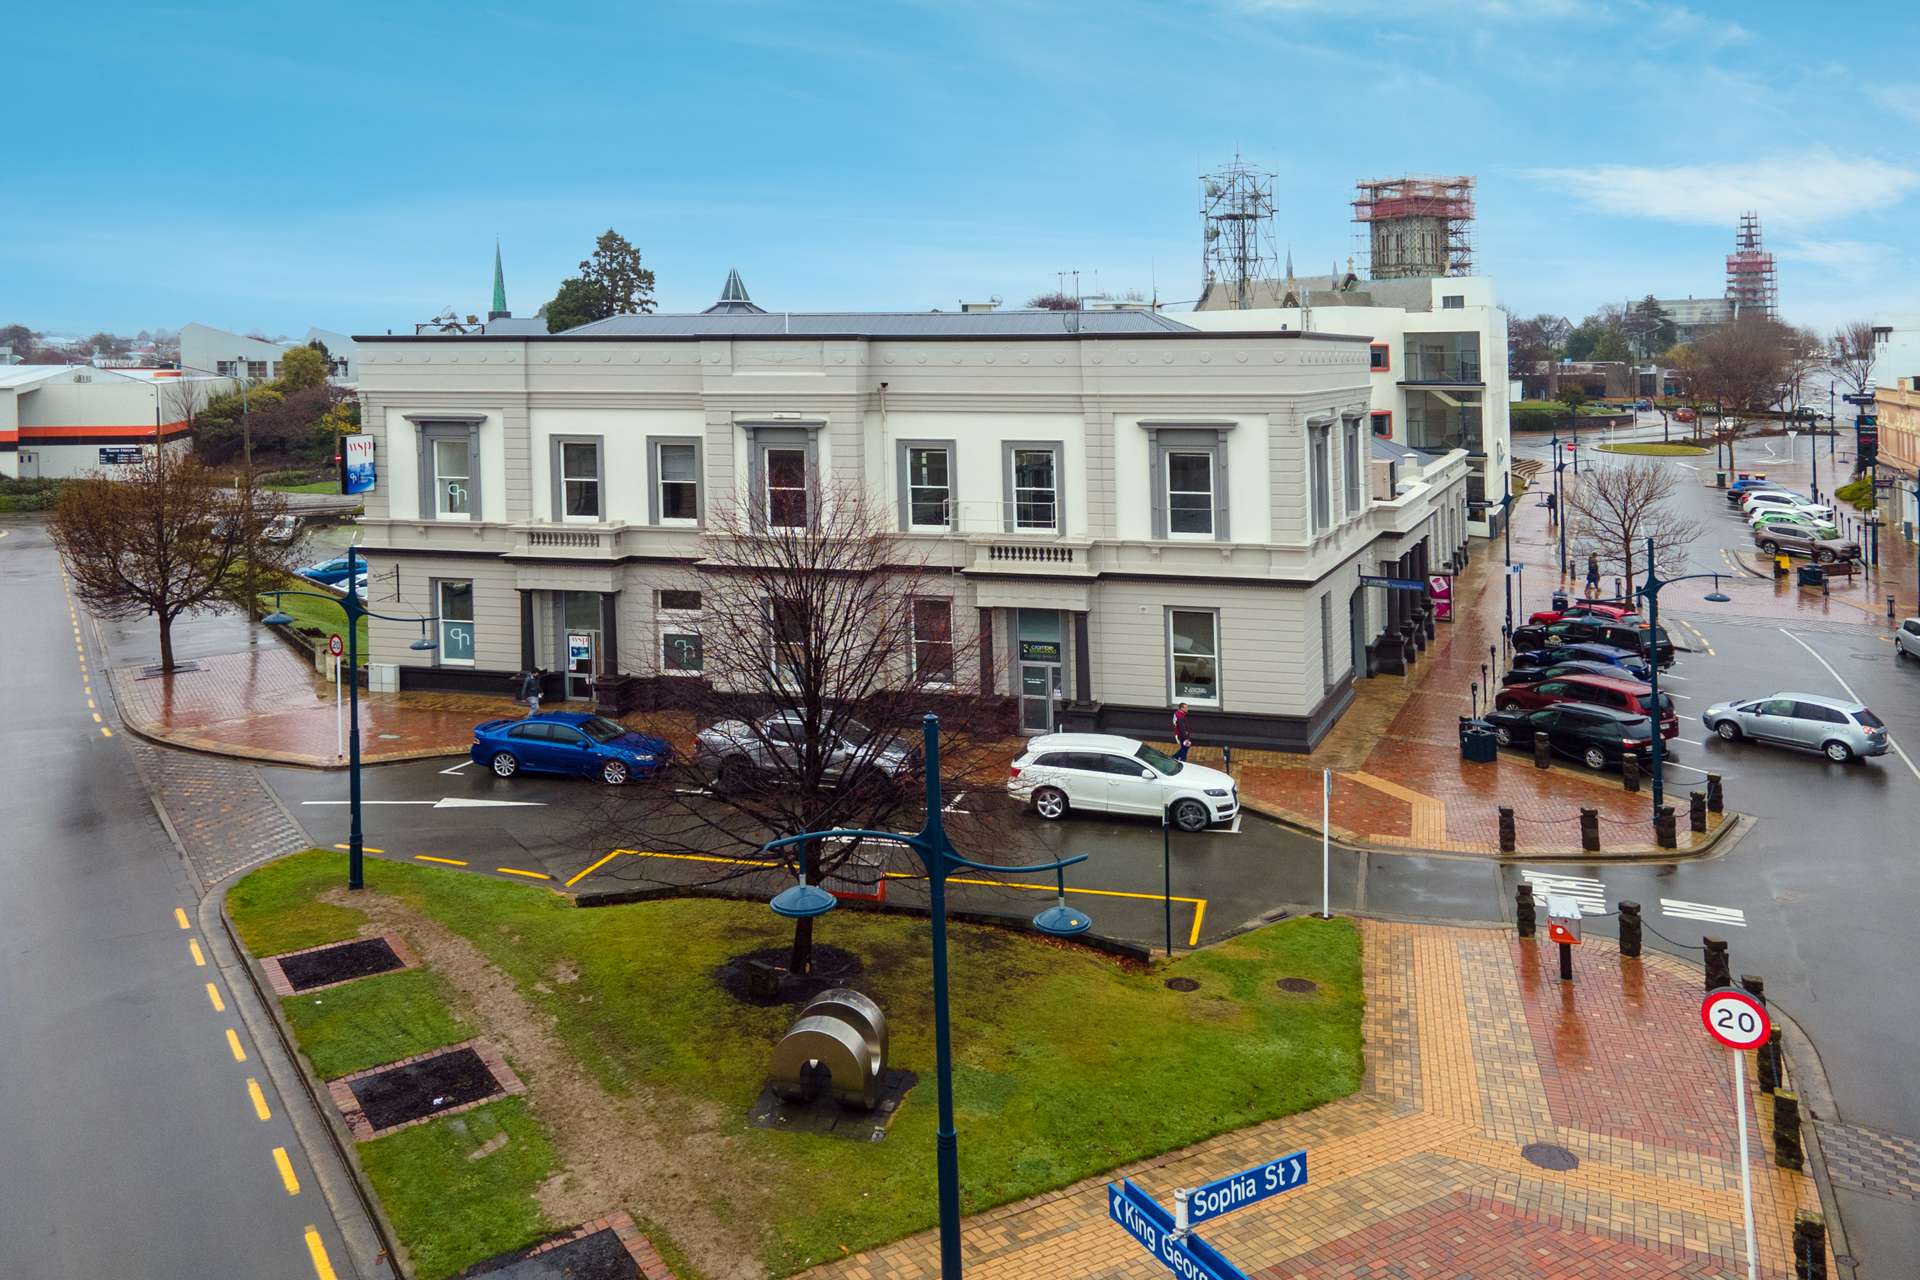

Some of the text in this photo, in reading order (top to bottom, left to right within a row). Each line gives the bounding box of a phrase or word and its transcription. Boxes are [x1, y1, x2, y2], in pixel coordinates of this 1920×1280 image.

[348, 441, 372, 457] wsp
[332, 639, 341, 650] 20
[571, 637, 589, 646] wsp
[1717, 1008, 1755, 1033] 20
[1194, 1162, 1286, 1216] Sophia St
[1124, 1201, 1208, 1280] King Geor
